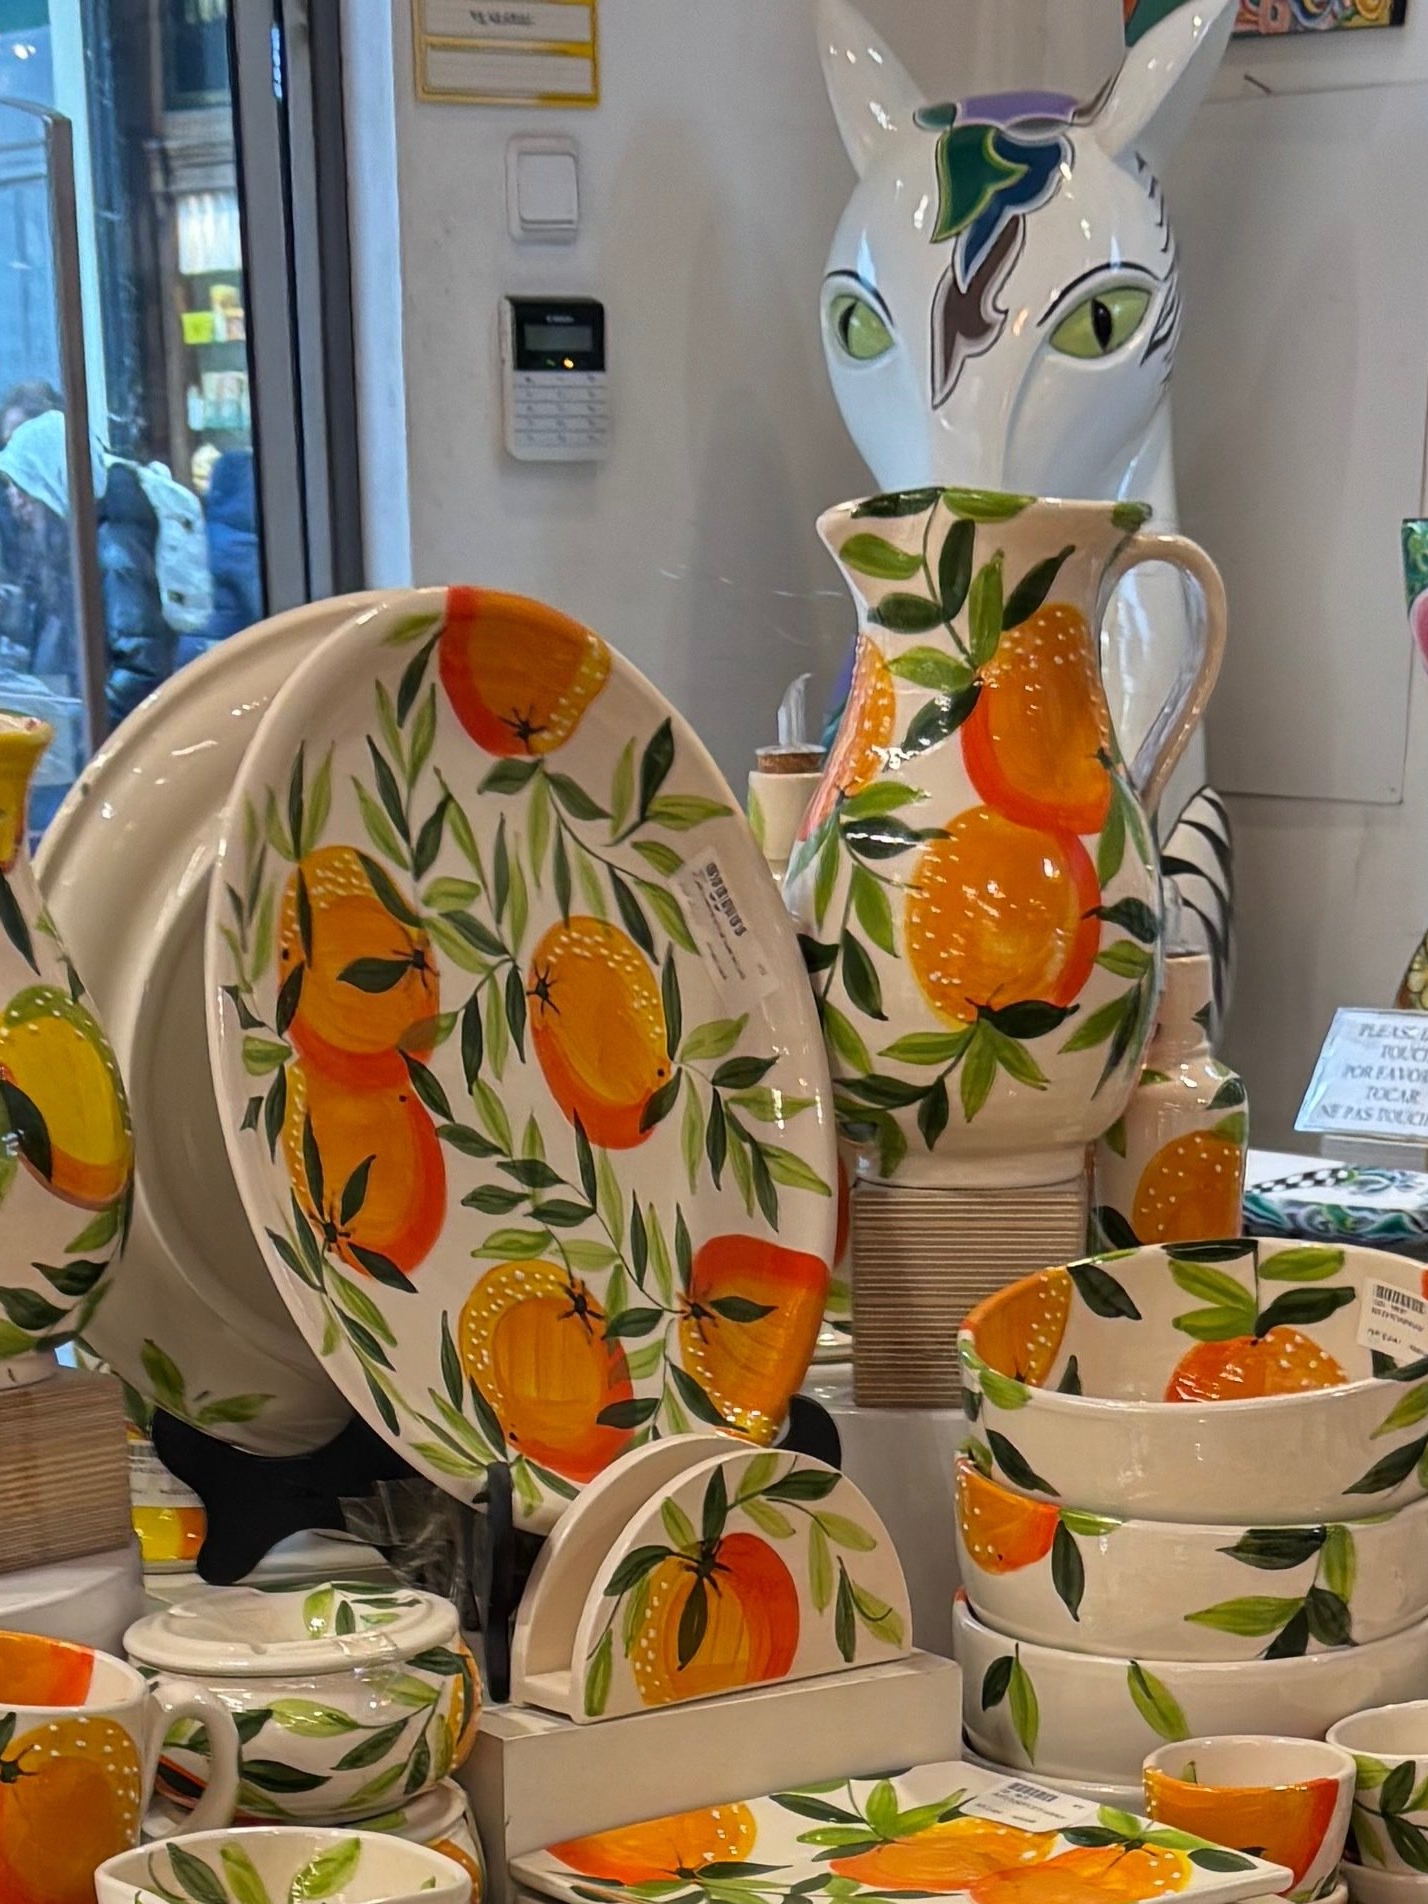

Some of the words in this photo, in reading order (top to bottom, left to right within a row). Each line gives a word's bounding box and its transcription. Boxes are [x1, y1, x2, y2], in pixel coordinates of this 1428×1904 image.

[1358, 1022, 1417, 1041] PLEASE
[1341, 1063, 1372, 1079] POR
[1365, 1085, 1422, 1104] TOCAR
[1321, 1103, 1342, 1119] NE
[1342, 1105, 1373, 1122] PAS
